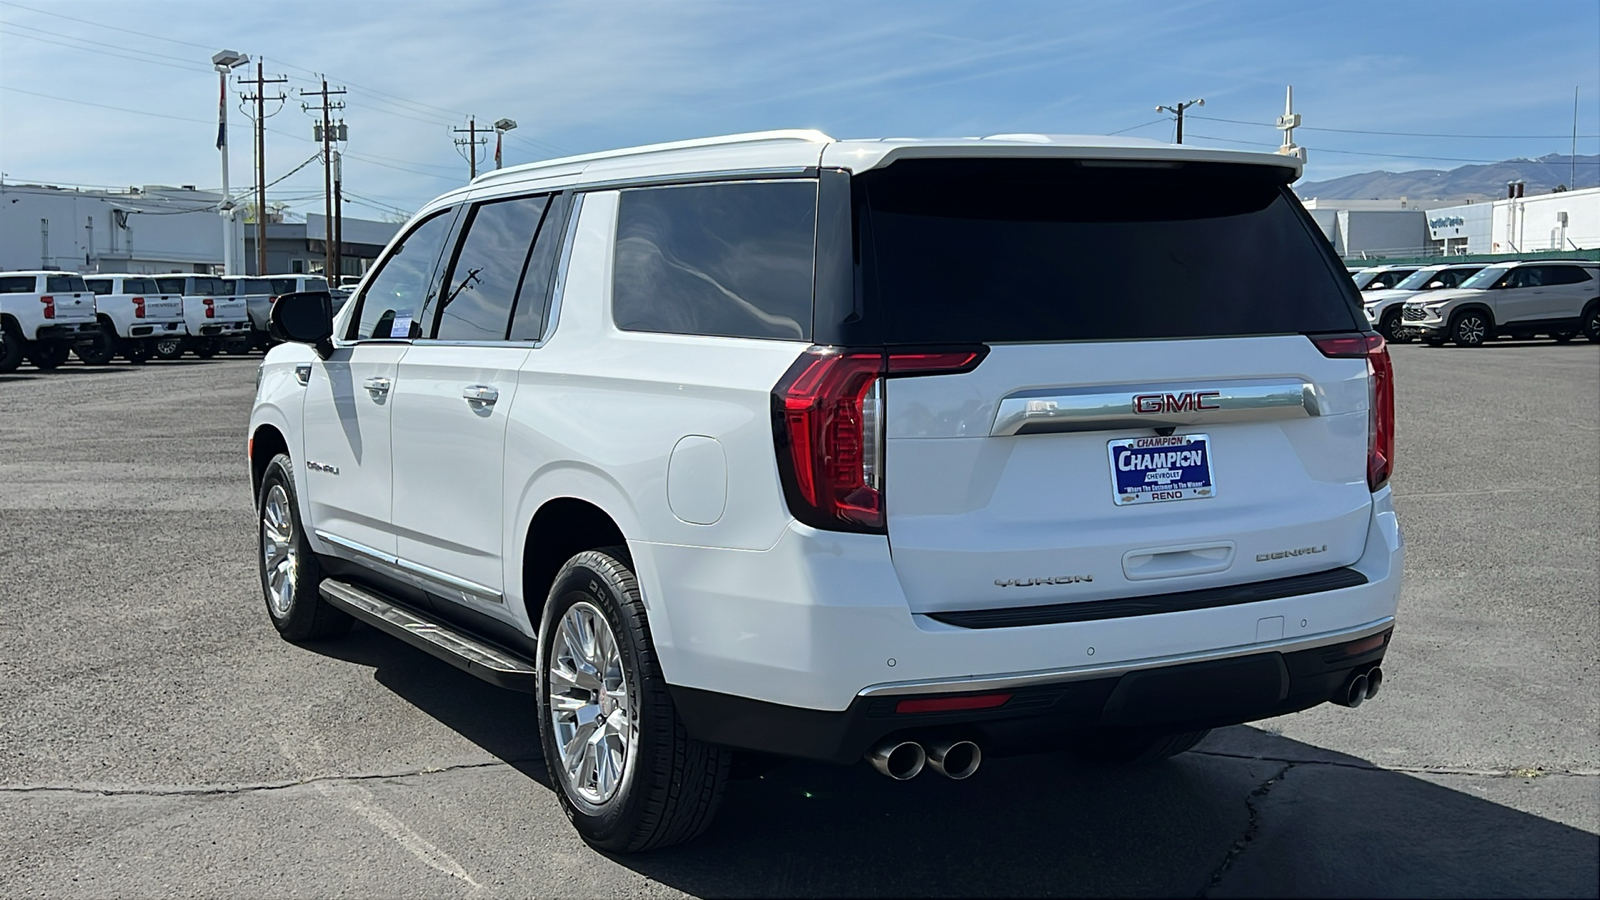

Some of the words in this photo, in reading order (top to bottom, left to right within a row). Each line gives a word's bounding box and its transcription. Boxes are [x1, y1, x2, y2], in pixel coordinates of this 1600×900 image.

[1132, 391, 1220, 414] GMC
[1137, 437, 1183, 448] CHAMPION
[1118, 450, 1202, 471] CHAMPION
[1146, 471, 1180, 480] CHEVROLET
[1152, 491, 1183, 501] RENO
[1256, 544, 1327, 562] DENALI
[994, 574, 1092, 587] YUKON
